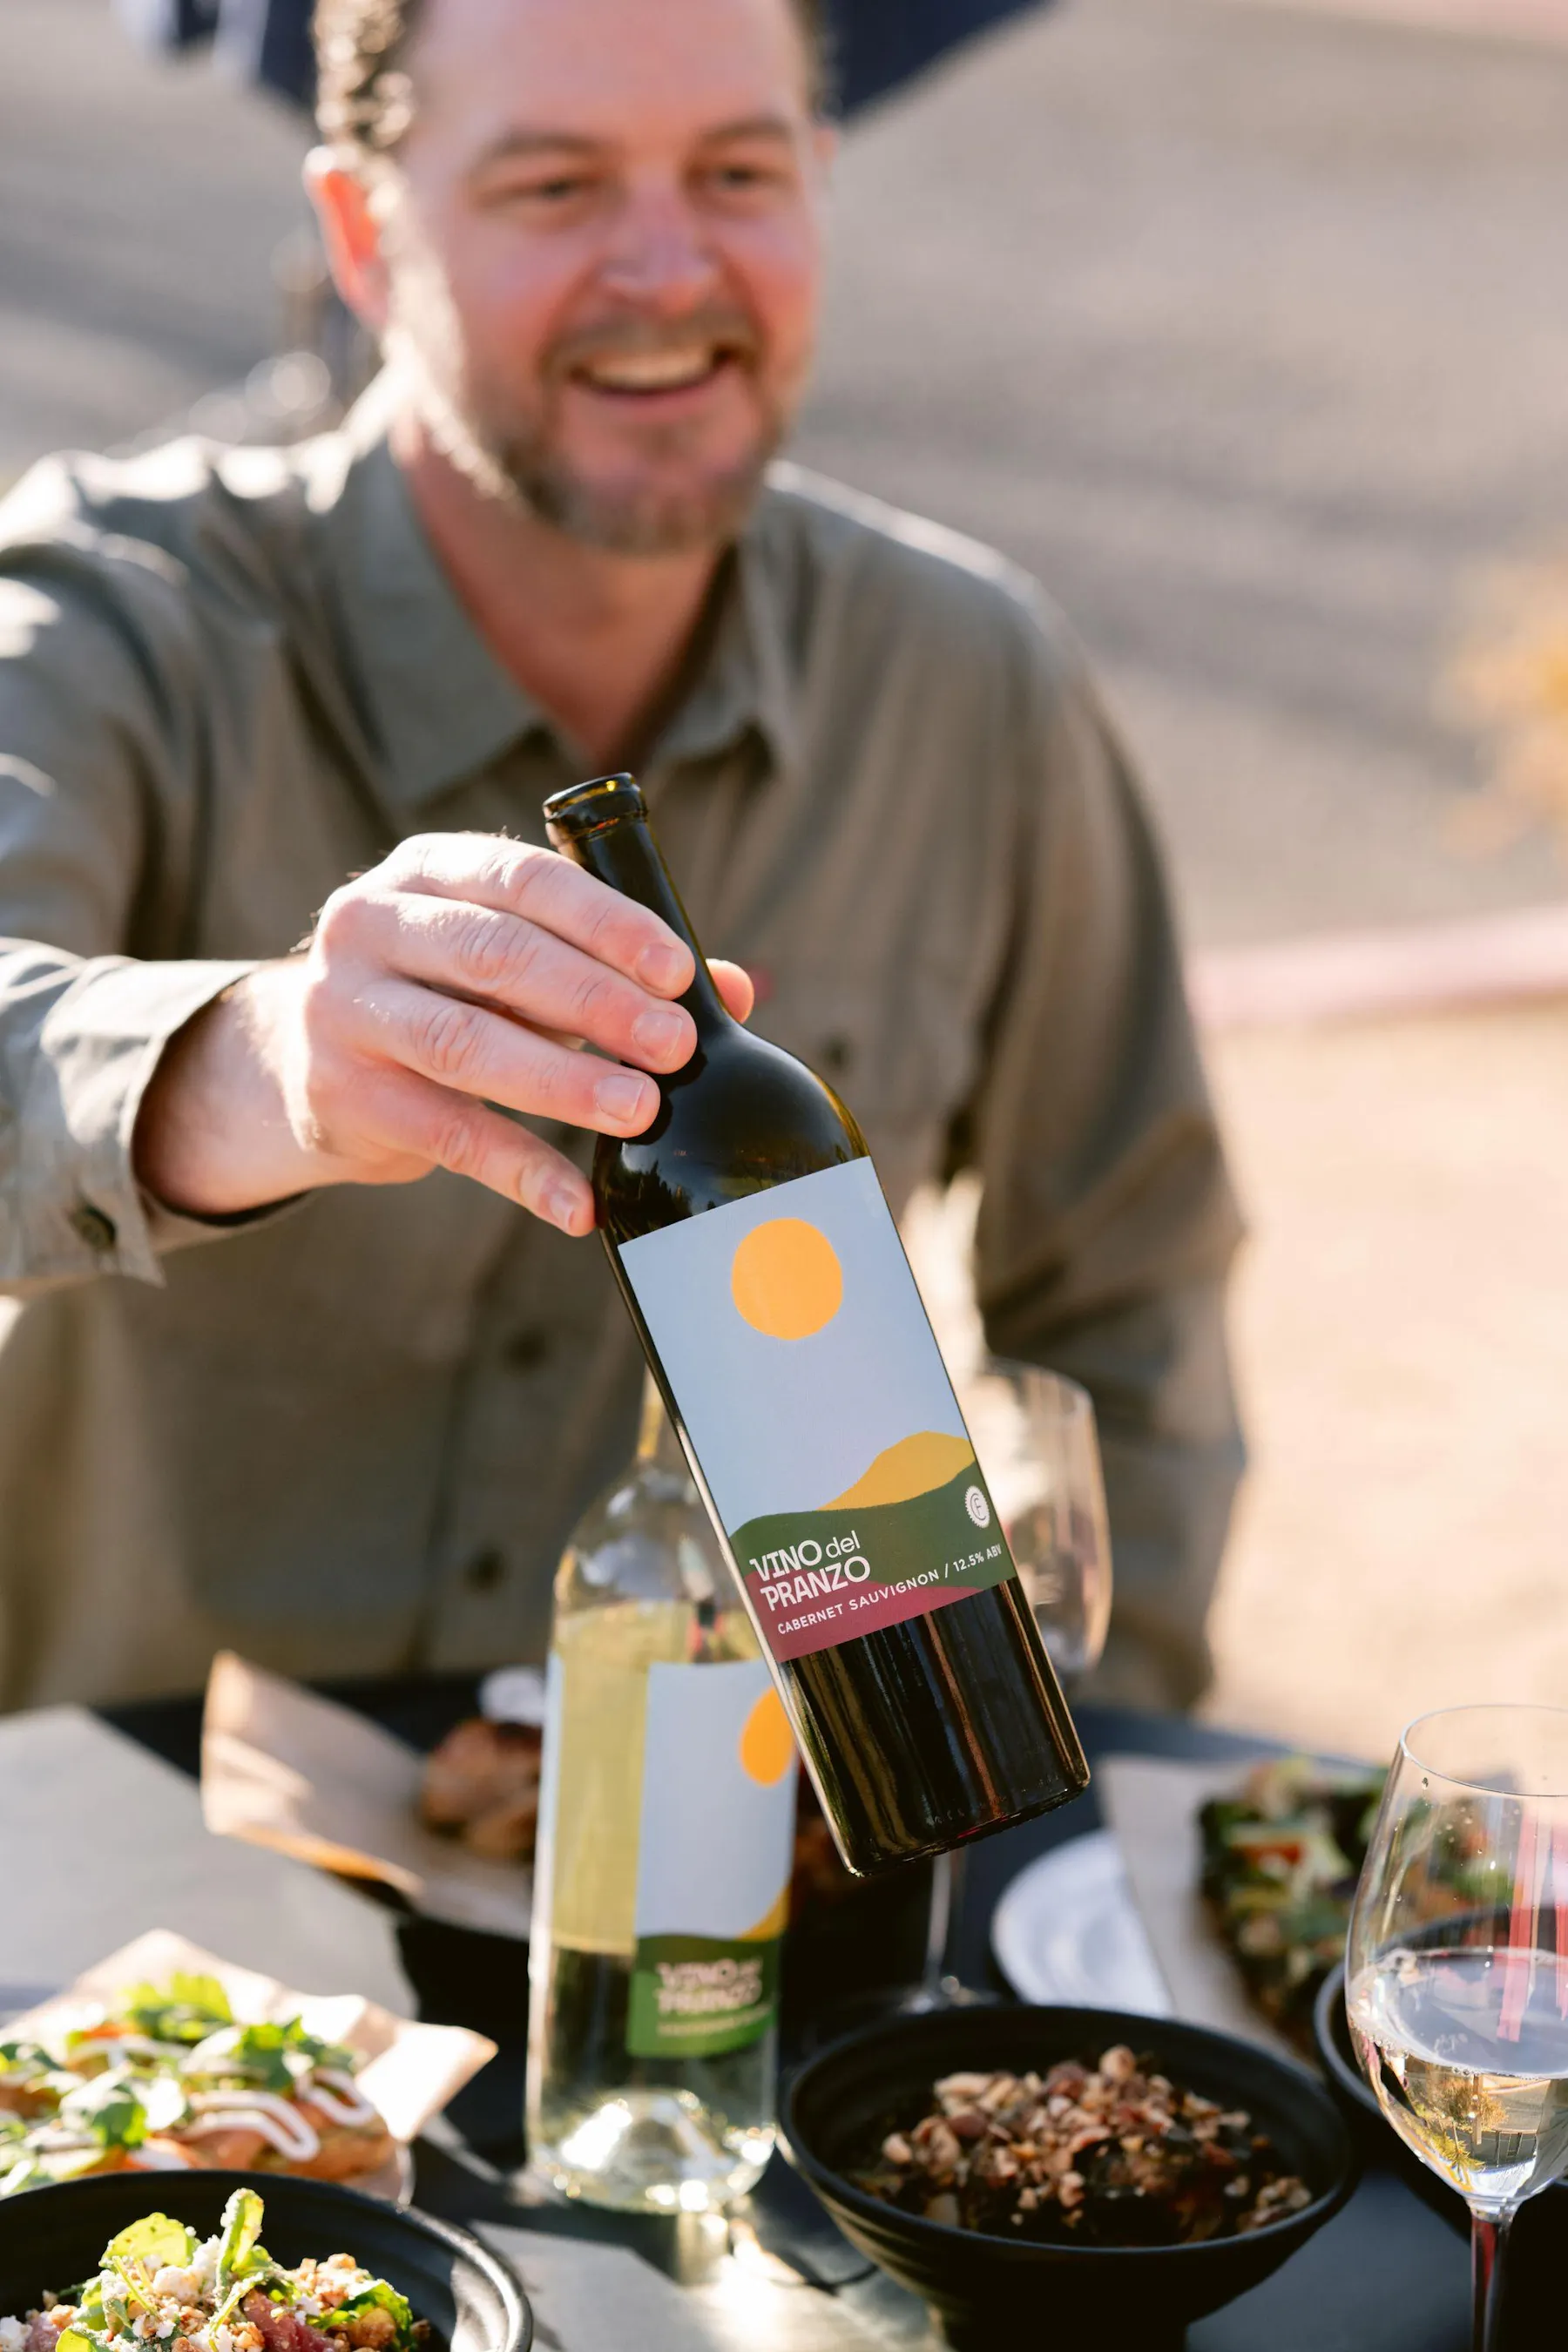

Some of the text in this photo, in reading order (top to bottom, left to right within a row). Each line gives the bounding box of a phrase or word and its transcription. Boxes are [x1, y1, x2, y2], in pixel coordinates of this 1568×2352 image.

[749, 1530, 861, 1582] VINO del
[760, 1556, 870, 1612] PRANZO
[777, 1604, 843, 1634] CABERNET
[848, 1569, 940, 1611] SAUVIGNON
[953, 1551, 984, 1571] 12.5%
[986, 1544, 1002, 1559] ABV
